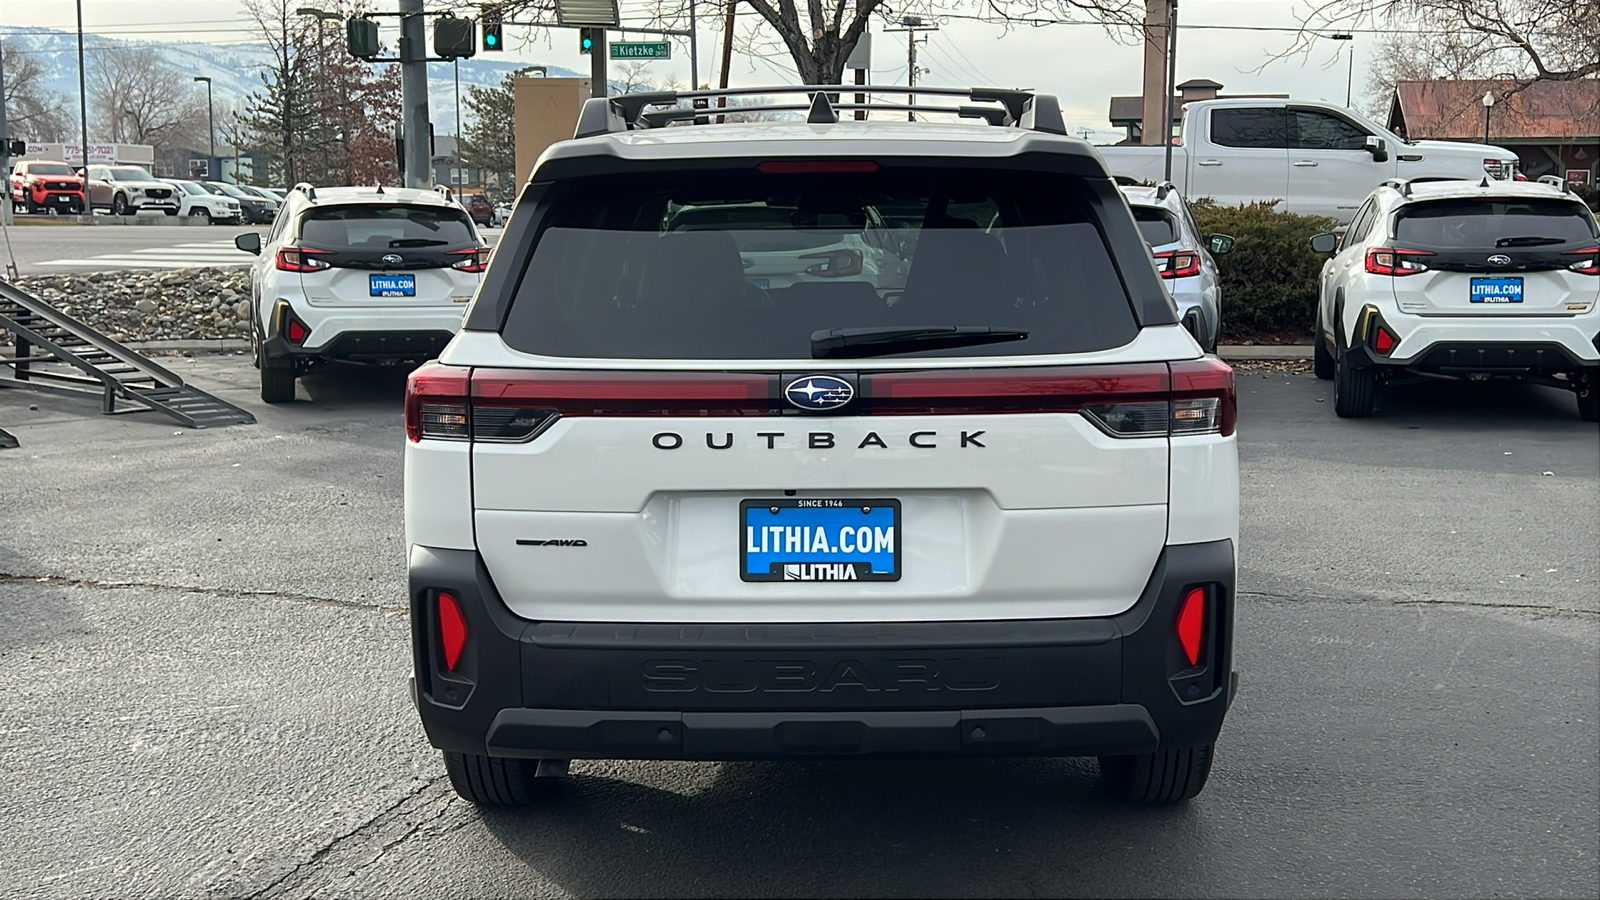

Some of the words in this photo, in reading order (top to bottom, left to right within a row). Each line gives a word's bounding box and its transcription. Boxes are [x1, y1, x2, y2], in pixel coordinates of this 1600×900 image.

[619, 45, 654, 56] Kietzke
[65, 145, 114, 155] 775-51-7021
[371, 280, 414, 289] LITHIA.COM
[1472, 285, 1522, 295] LITHIA.COM
[652, 431, 986, 450] OUTBACK
[542, 539, 588, 547] AWD
[747, 526, 894, 553] LITHIA.COM
[801, 564, 857, 580] LITHIA
[643, 659, 1000, 693] SUBARU
